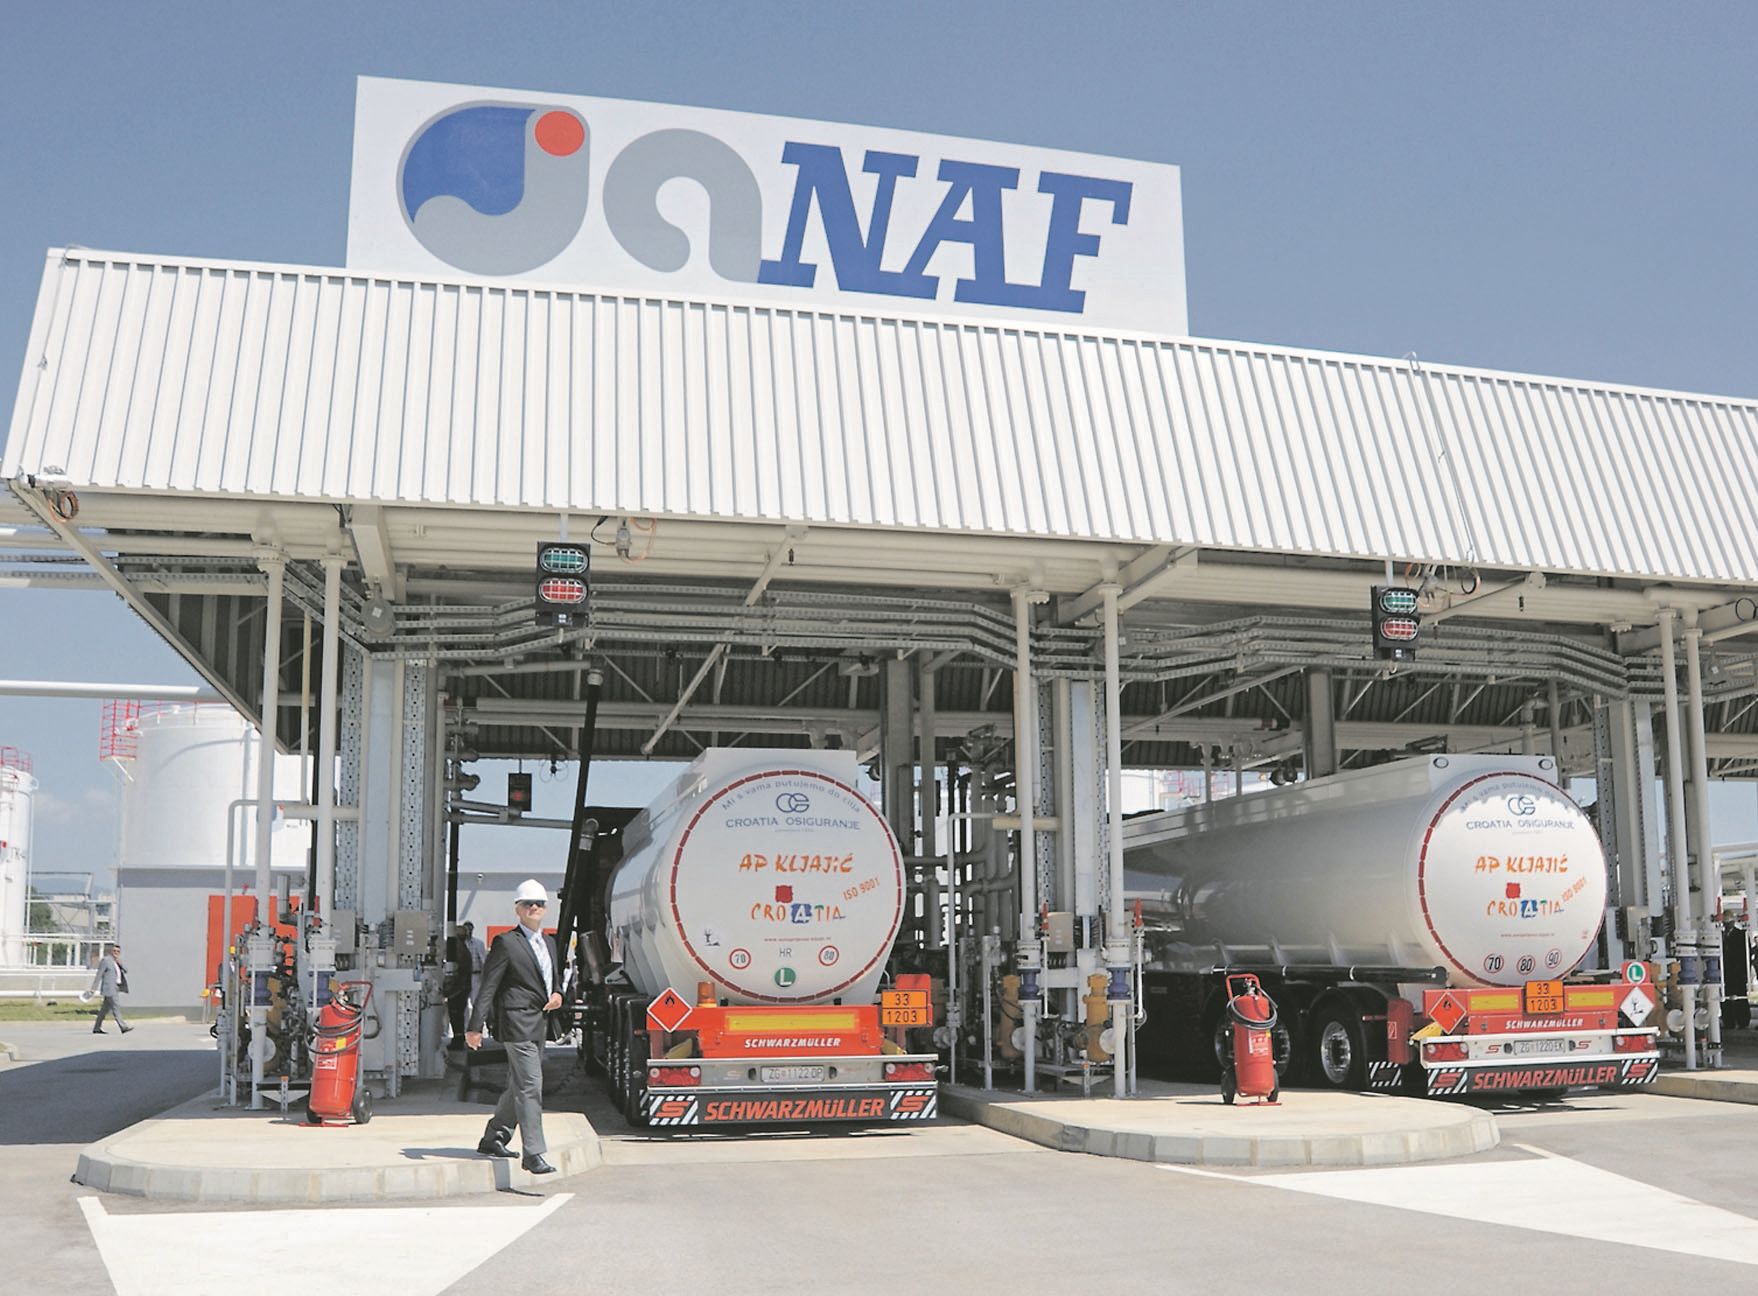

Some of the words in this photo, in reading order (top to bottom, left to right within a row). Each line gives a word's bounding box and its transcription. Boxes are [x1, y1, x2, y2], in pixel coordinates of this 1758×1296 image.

[725, 816, 778, 829] CROATIA
[785, 816, 862, 831] OSIGURANJE
[1466, 819, 1513, 830] CROATIA
[739, 854, 768, 872] AP
[1475, 856, 1500, 873] AP
[843, 887, 858, 901] ISO
[860, 877, 880, 894] 9001
[751, 903, 846, 923] CROATIA
[1487, 900, 1565, 918] CROATIA
[735, 954, 746, 964] 70
[779, 948, 792, 958] HR
[823, 951, 835, 961] 80
[1548, 951, 1559, 966] 90
[1488, 957, 1501, 971] 70
[1520, 958, 1533, 972] 80
[780, 969, 792, 985] L
[1632, 966, 1642, 980] L
[1537, 983, 1549, 995] 33
[895, 993, 909, 1006] 33
[1531, 998, 1557, 1011] 1203
[887, 1010, 917, 1023] 1203
[1472, 1066, 1617, 1090] SCHWARZMÜLLER
[704, 1098, 885, 1121] SCHWARZMÜLLER
